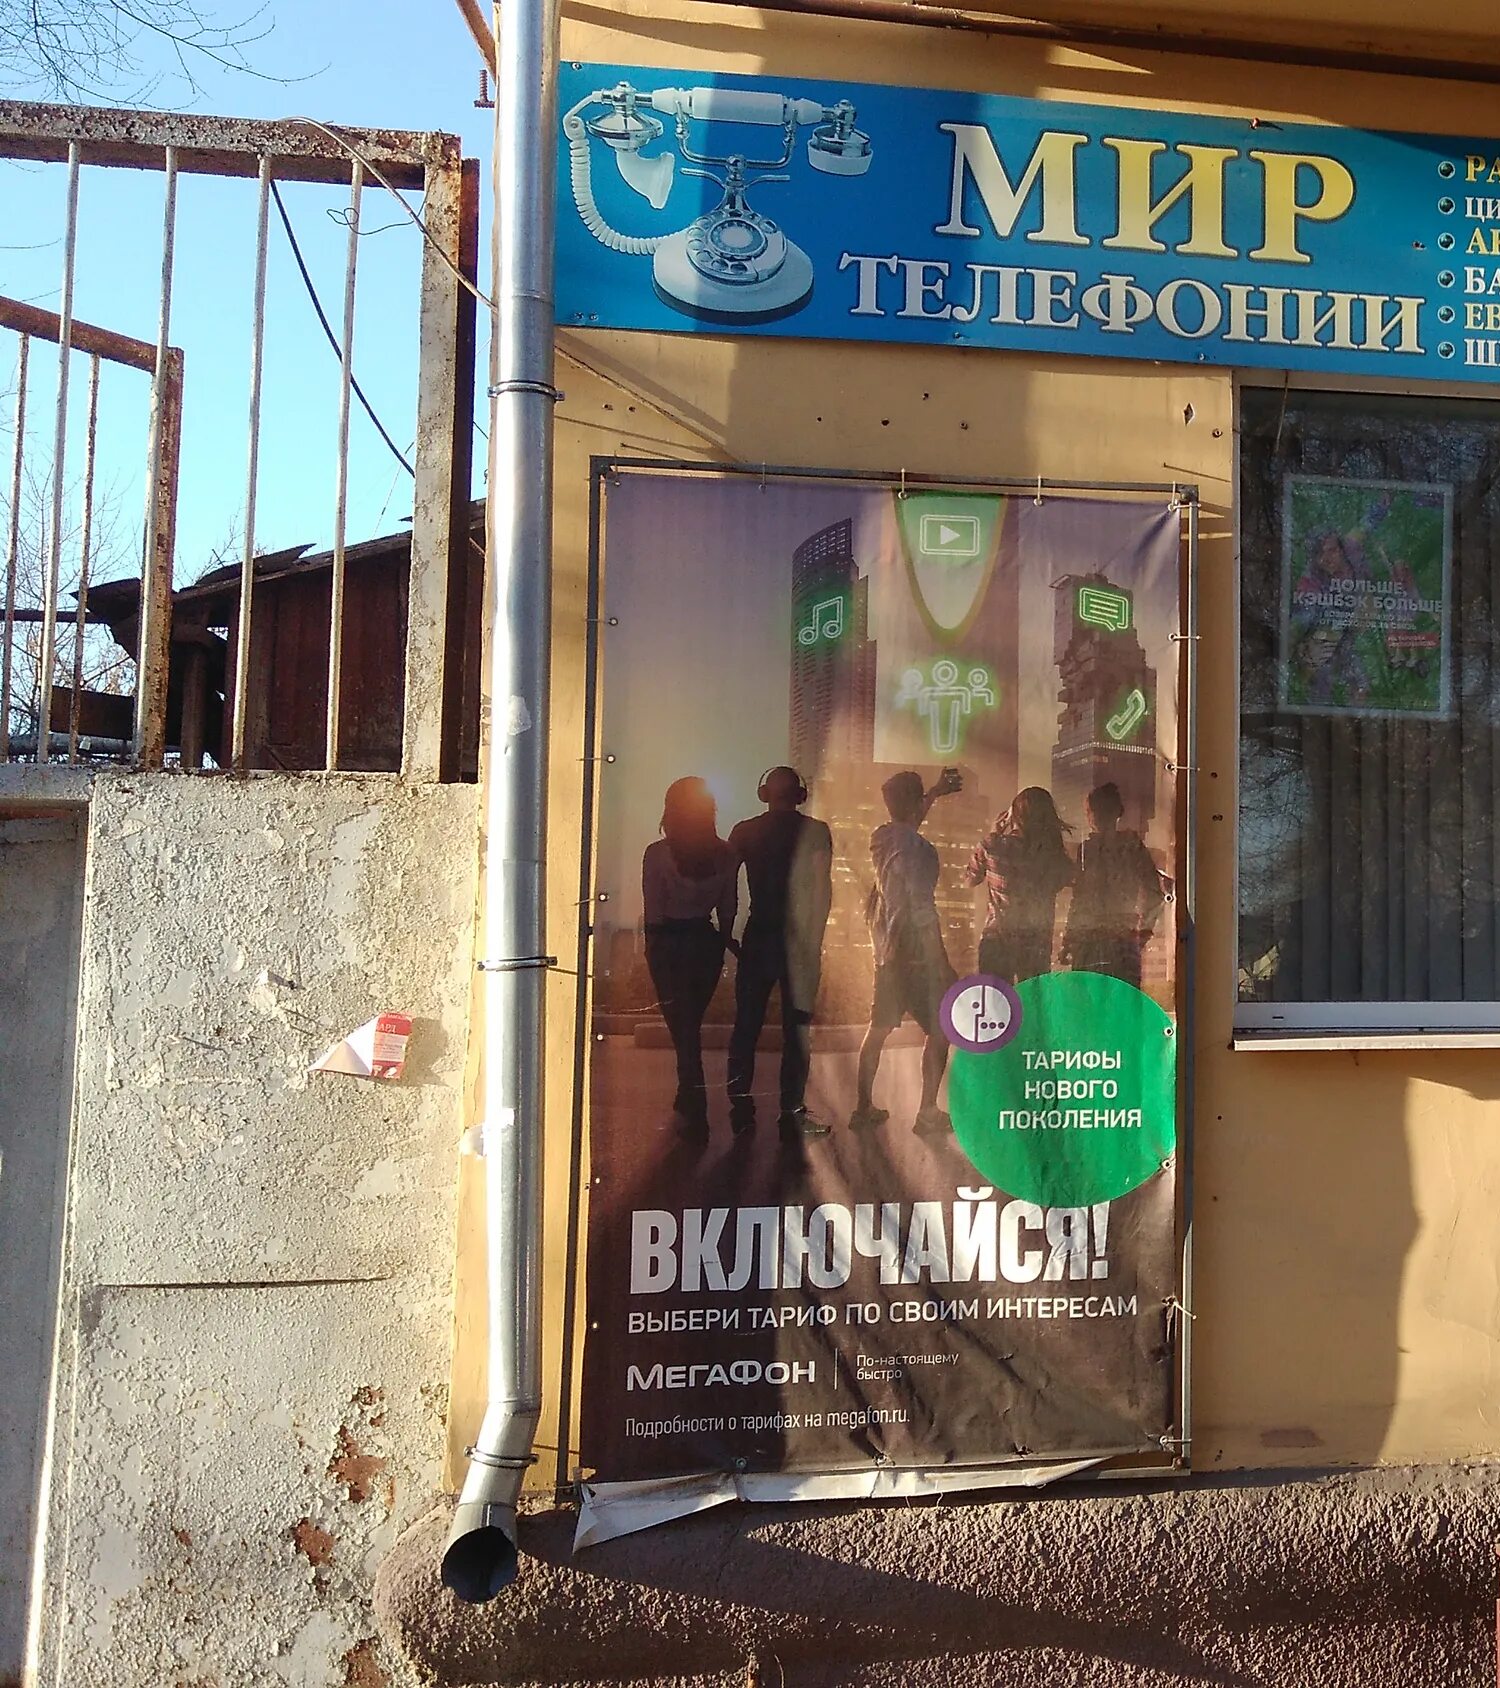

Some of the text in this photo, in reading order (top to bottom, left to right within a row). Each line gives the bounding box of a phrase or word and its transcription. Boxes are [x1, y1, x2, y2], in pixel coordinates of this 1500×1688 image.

[935, 121, 1356, 264] МИР
[838, 252, 1427, 354] ТЕЛЕФОНИИ
[1022, 1050, 1121, 1070] ТАРИФЫ
[1024, 1079, 1118, 1100] НОВОГО
[999, 1109, 1142, 1130] ПОКОЛЕНИЯ
[629, 1185, 1111, 1294] ВКЛЮЧАЙСЯ!
[627, 1294, 1139, 1334] ВЫБЕРИ ТАРИФ ПО СВОИМ ИНТЕРЕСАМ
[856, 1353, 960, 1368] По-настоящему
[856, 1368, 903, 1384] быстро
[625, 1406, 911, 1438] Подробности о тарифах на megafon.ru.
